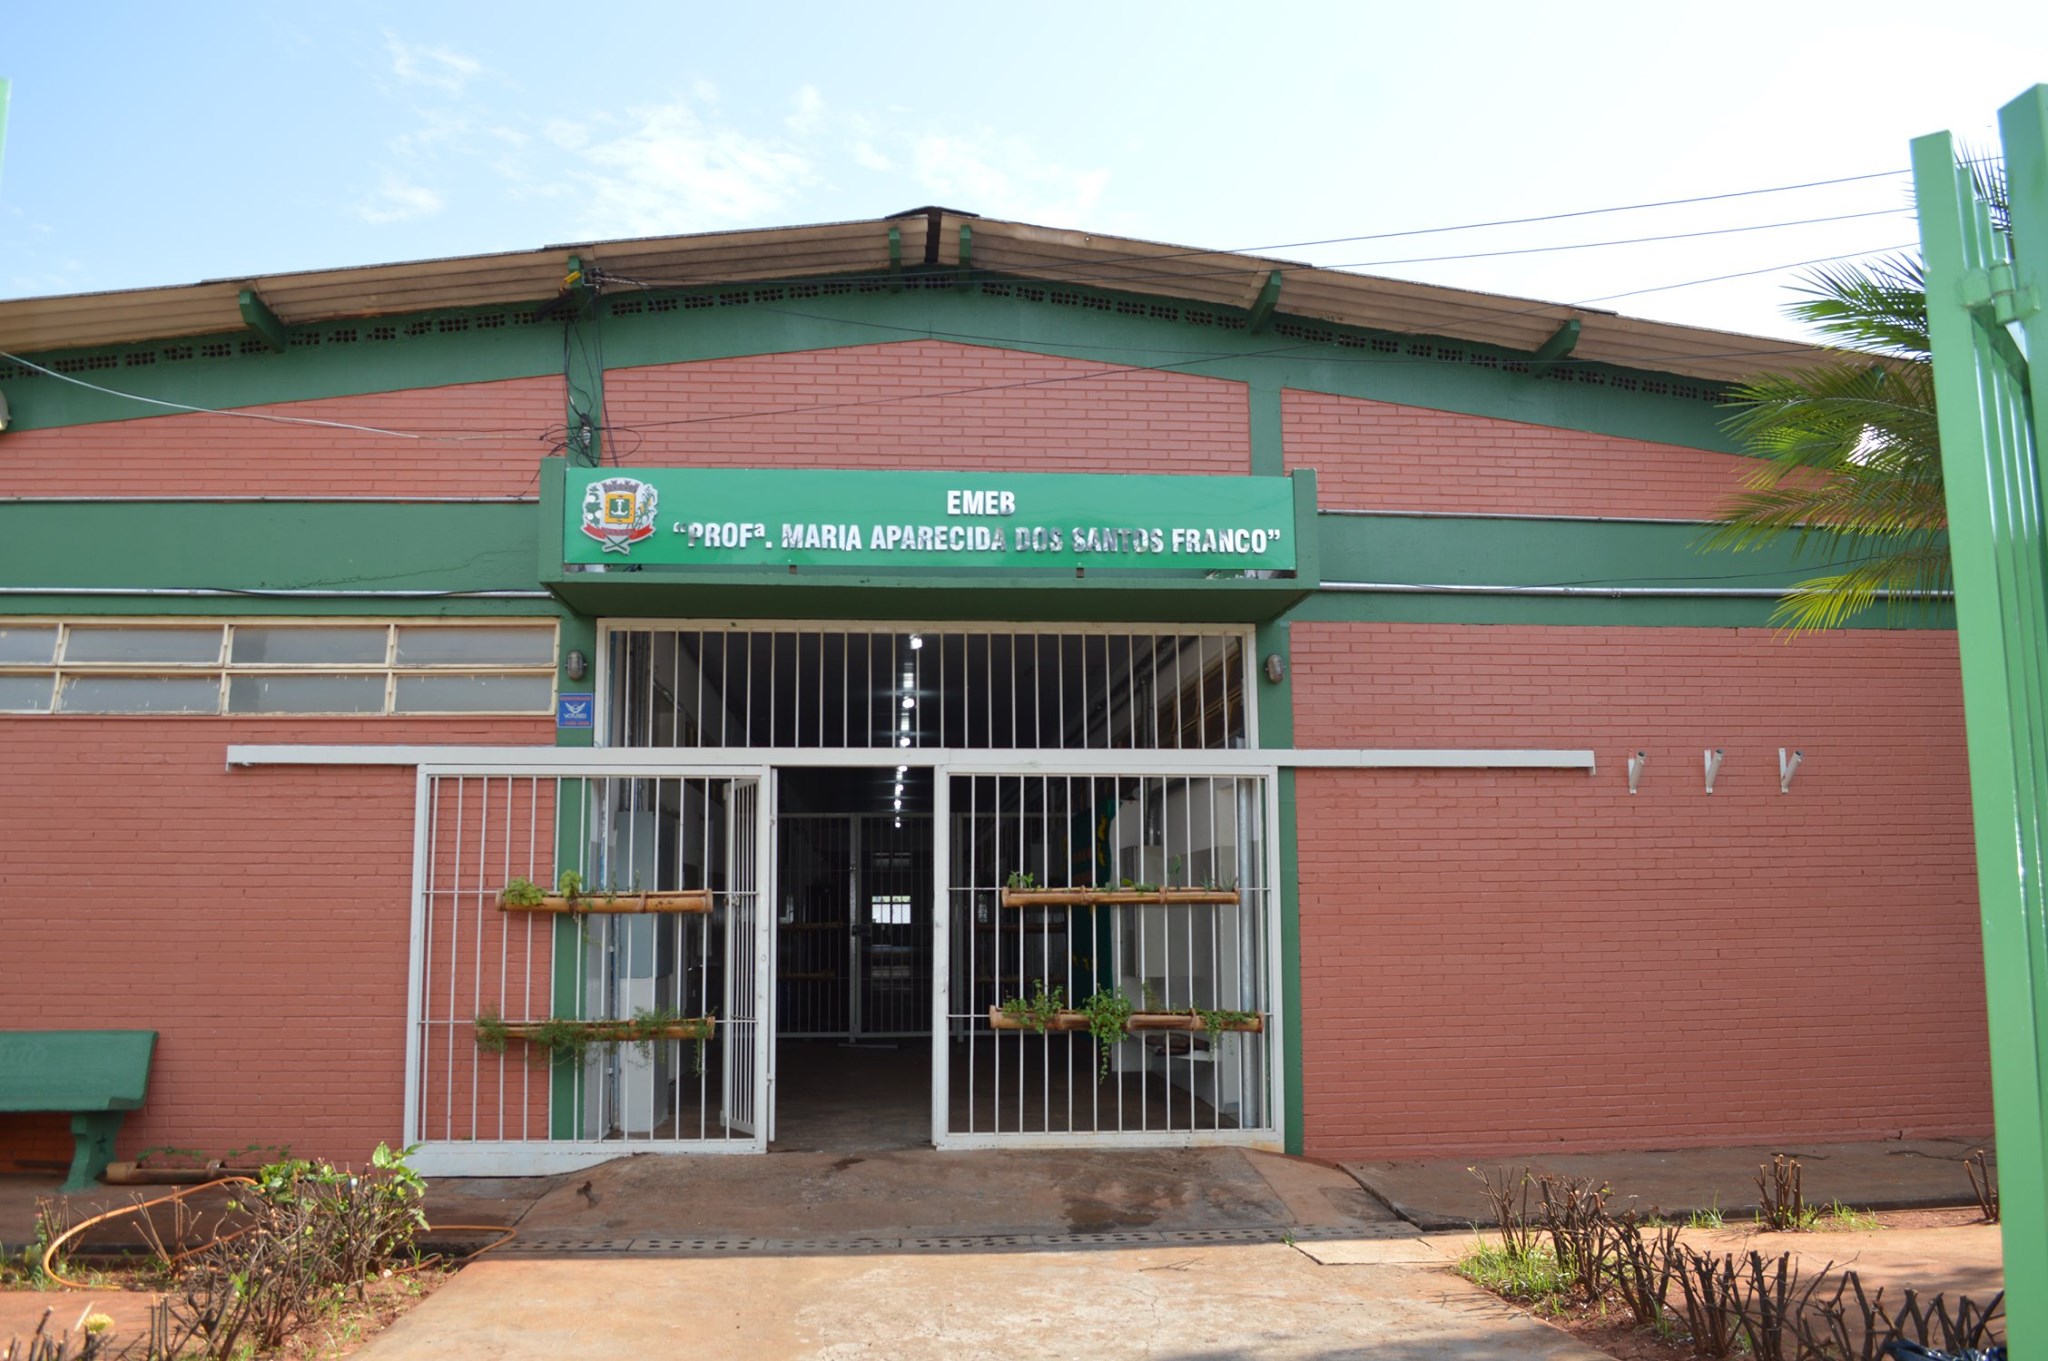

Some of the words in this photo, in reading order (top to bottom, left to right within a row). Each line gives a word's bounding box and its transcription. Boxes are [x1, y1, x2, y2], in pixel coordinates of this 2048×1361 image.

[947, 490, 1015, 514] EMEB
[782, 524, 862, 551] MARIA
[870, 525, 1006, 551] APARECIDA
[1015, 526, 1063, 552] DOS
[1071, 527, 1163, 553] SANTOS
[1172, 528, 1280, 554] FRANCO”
